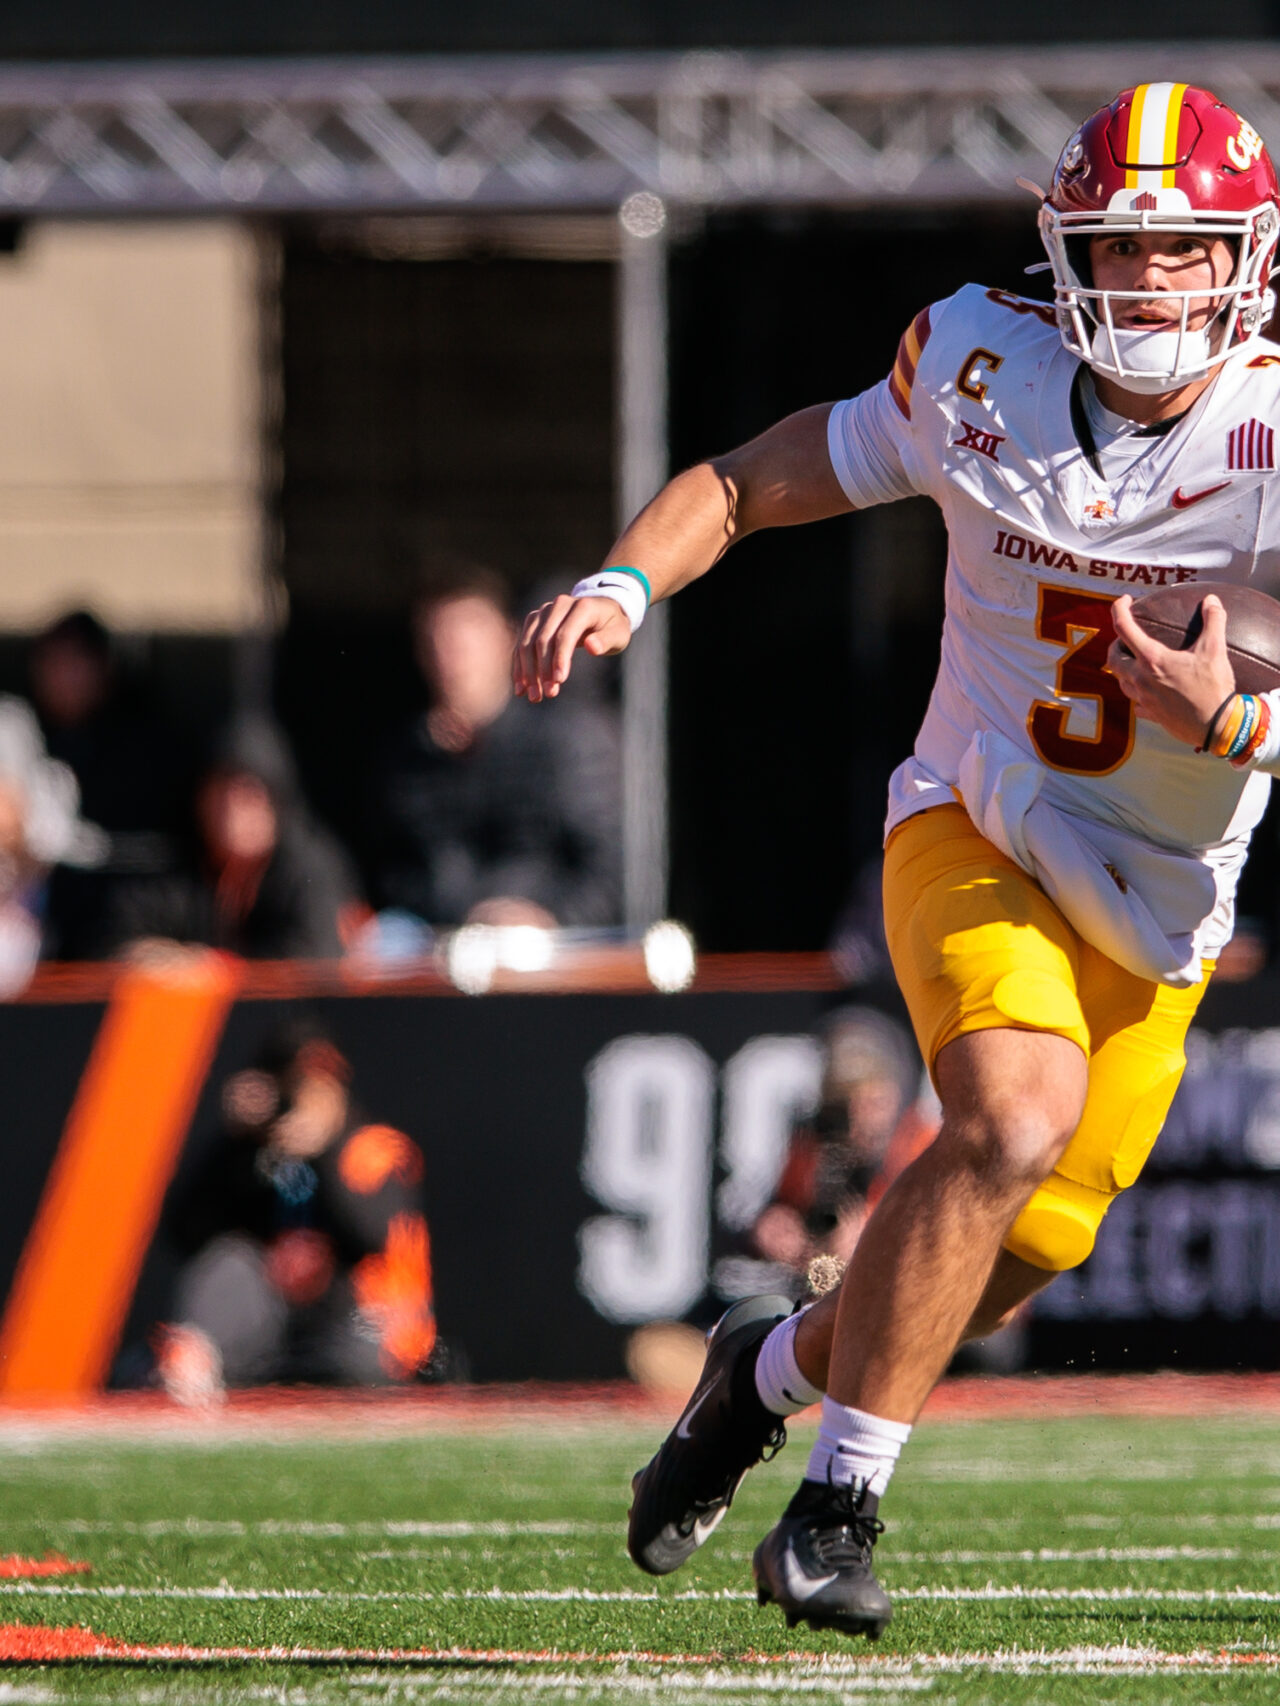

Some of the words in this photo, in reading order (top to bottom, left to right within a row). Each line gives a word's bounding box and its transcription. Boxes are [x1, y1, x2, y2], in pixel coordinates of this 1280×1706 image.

[956, 346, 1005, 404] C
[952, 419, 1006, 463] XII
[992, 531, 1078, 573] IOWA
[1088, 559, 1198, 586] STATE
[1026, 582, 1137, 777] 3
